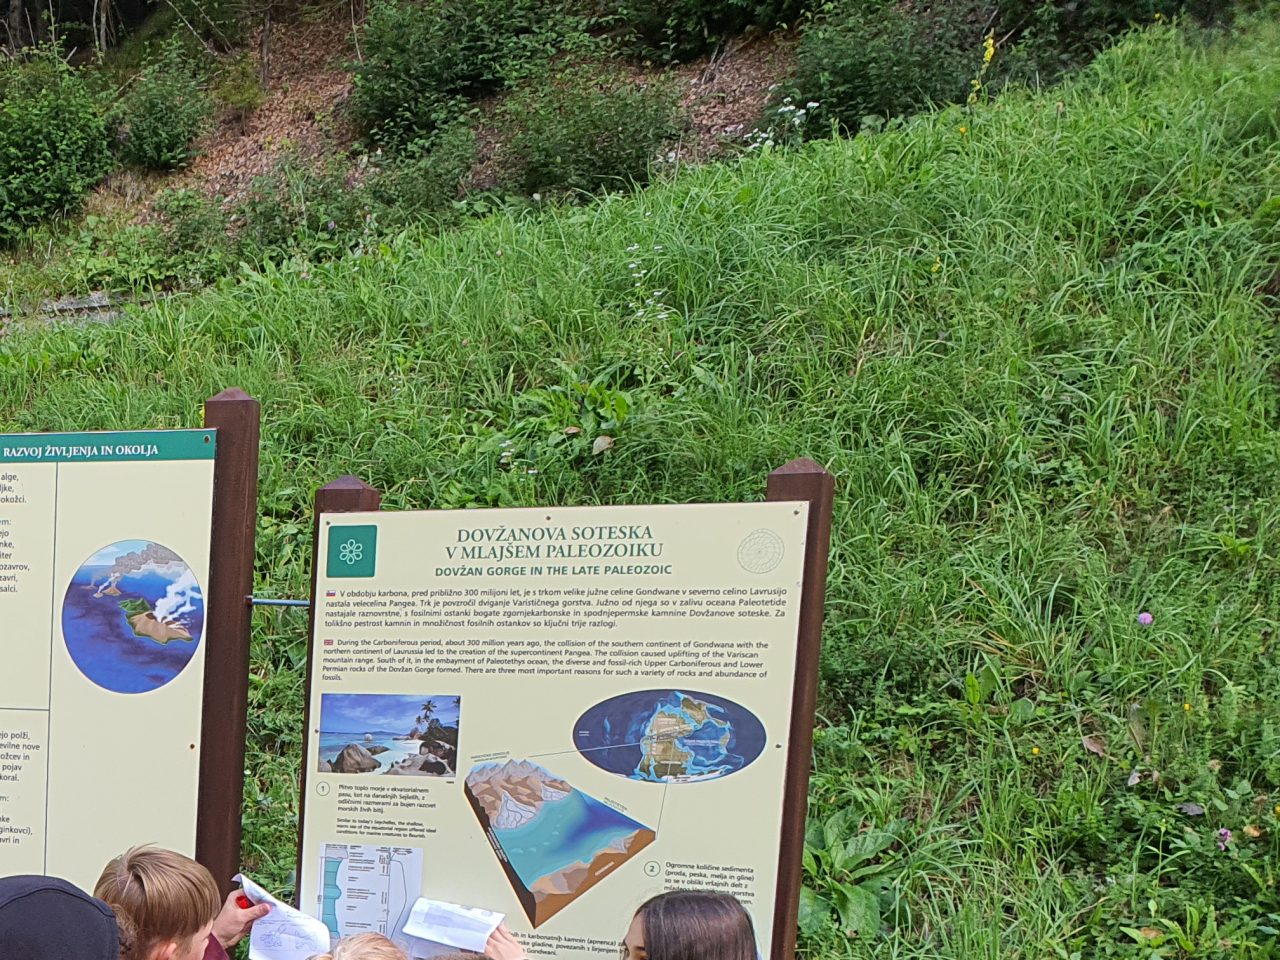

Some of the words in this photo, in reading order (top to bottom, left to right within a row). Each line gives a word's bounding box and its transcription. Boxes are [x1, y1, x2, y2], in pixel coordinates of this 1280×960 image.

[3, 447, 43, 458] RAZVOJ
[45, 445, 99, 458] ŽIVLJENJA
[101, 445, 114, 456] IN
[115, 445, 159, 457] OKOLJA
[0, 472, 20, 483] alge,
[457, 526, 567, 542] DOVŽANOVA
[571, 526, 653, 540] SOTESKA
[446, 546, 458, 560] V
[461, 543, 541, 561] MLAJŠEM
[546, 543, 664, 558] PALEOZOIKU
[435, 566, 483, 577] DOVŽAN
[486, 566, 527, 576] GORGE
[530, 566, 543, 576] IN
[546, 566, 568, 576] THE
[572, 566, 600, 576] LATE
[604, 565, 673, 575] PALEOZOIC
